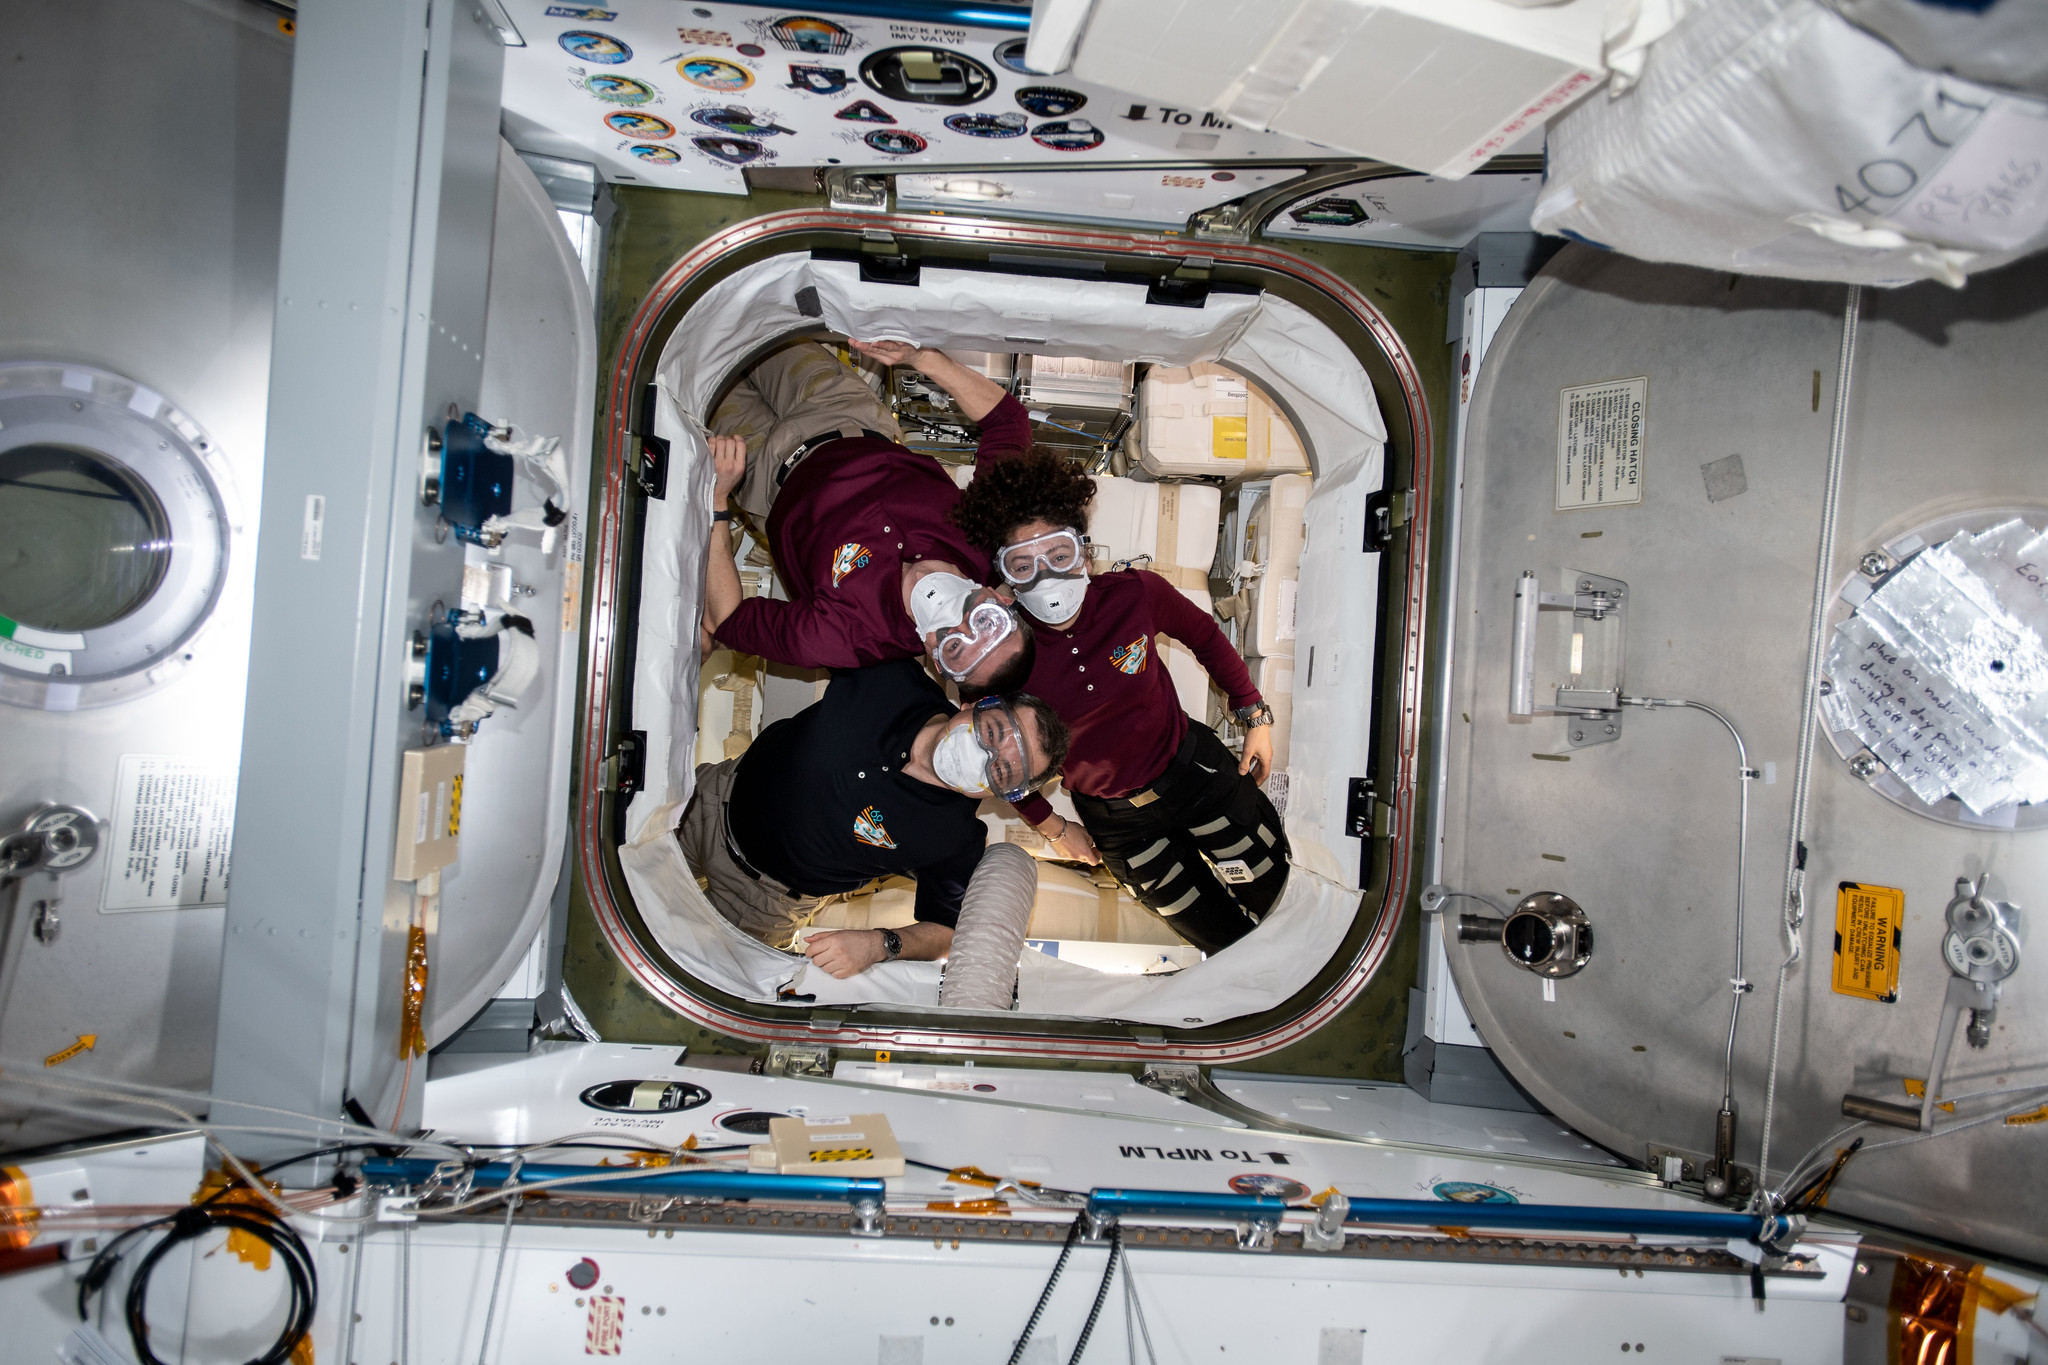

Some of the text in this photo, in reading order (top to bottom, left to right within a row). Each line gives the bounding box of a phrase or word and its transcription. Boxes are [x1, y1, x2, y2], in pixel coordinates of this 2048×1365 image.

[889, 24, 966, 38] DECK FWD
[891, 32, 965, 45] IMV VALVE
[1159, 107, 1233, 130] To M
[1628, 401, 1640, 485] CLOSING HATCH
[855, 555, 869, 568] 62
[1112, 645, 1128, 659] 62
[1904, 669, 1919, 684] on
[1849, 677, 1882, 707] switch
[1859, 662, 1895, 698] during
[1898, 696, 1906, 706] a
[1910, 708, 1934, 730] day
[1858, 709, 1882, 737] Then
[1887, 737, 1912, 763] look
[136, 775, 145, 804] STOWAGE
[144, 775, 154, 804] STOWAGE
[160, 775, 169, 804] STOWAGE
[176, 775, 184, 800] RATCHET
[167, 788, 176, 812] HANDLE
[189, 798, 197, 822] HANDLE
[133, 806, 141, 825] LATCH
[141, 806, 149, 825] LATCH
[149, 807, 158, 826] travel
[157, 806, 165, 825] LATCH
[173, 806, 181, 825] LATCH
[870, 810, 884, 825] 62
[129, 827, 138, 852] HANDLE
[138, 827, 146, 852] BUTTON
[153, 826, 162, 851] HANDLE
[170, 775, 192, 898] PRESSURE EQUALIZATION VALVE CLOSED.
[185, 827, 193, 850] Stowed
[193, 813, 203, 850] UNLATCHED.
[145, 835, 154, 856] stowed
[204, 848, 213, 876] UNLATCH
[147, 880, 156, 897] Move
[1869, 921, 1875, 930] TO
[1861, 921, 1869, 958] UNLATCHING
[1874, 917, 1888, 971] WARNING
[1119, 1145, 1261, 1164] To MPLM
